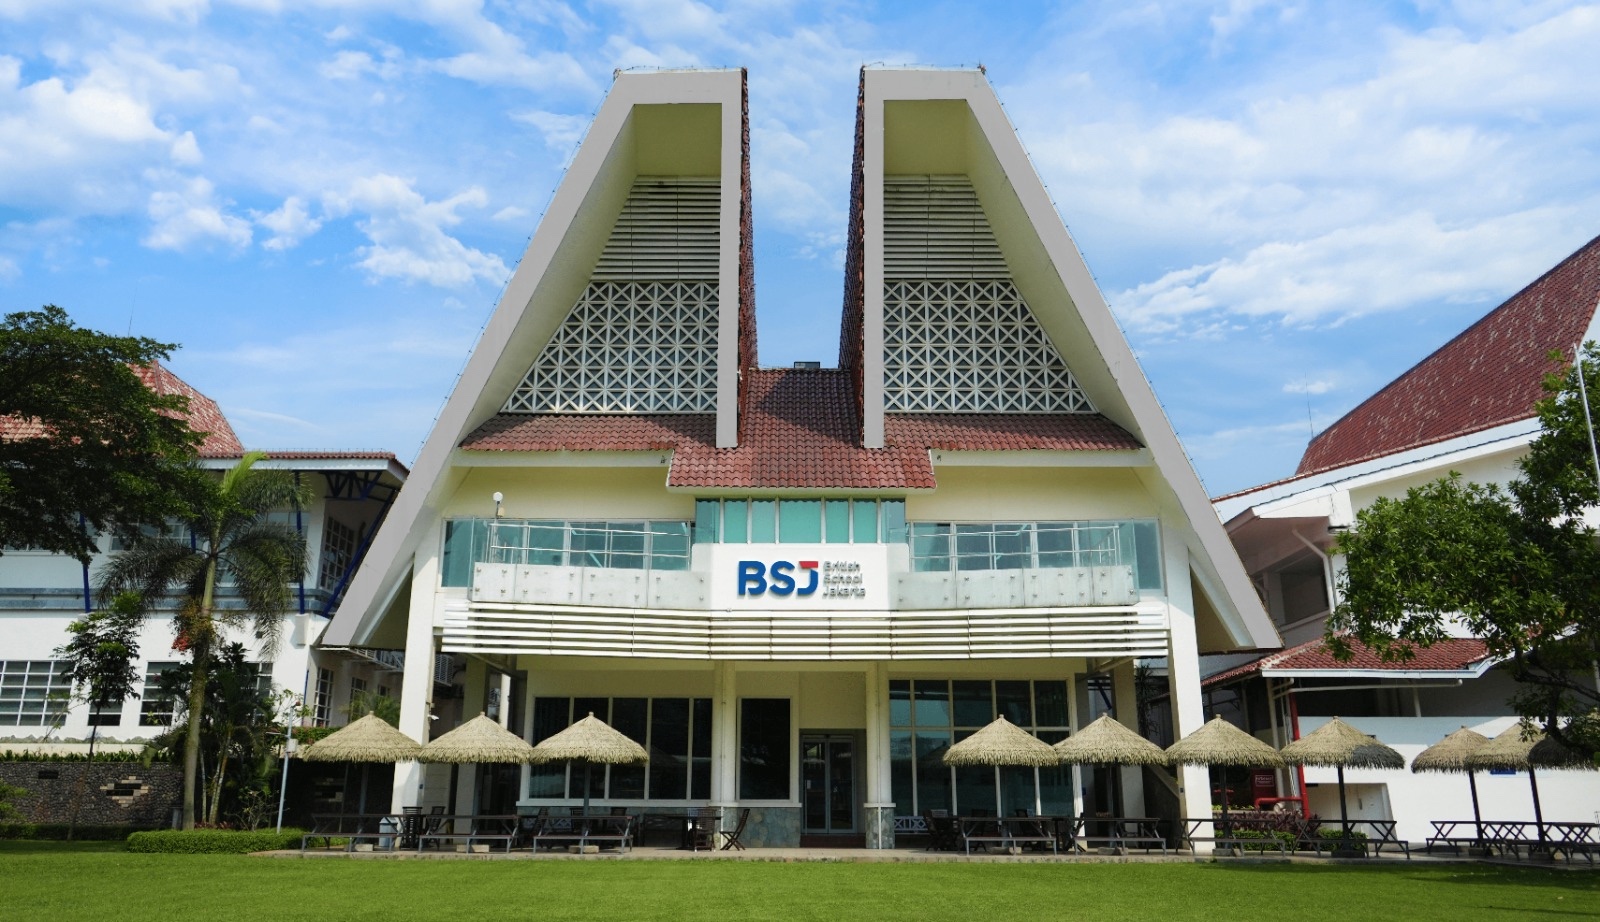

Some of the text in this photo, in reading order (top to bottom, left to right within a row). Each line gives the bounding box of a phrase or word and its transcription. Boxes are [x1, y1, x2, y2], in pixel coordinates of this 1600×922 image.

[823, 561, 860, 572] British
[738, 561, 819, 596] BSJ
[823, 573, 863, 584] School
[822, 586, 866, 597] Jakarta
